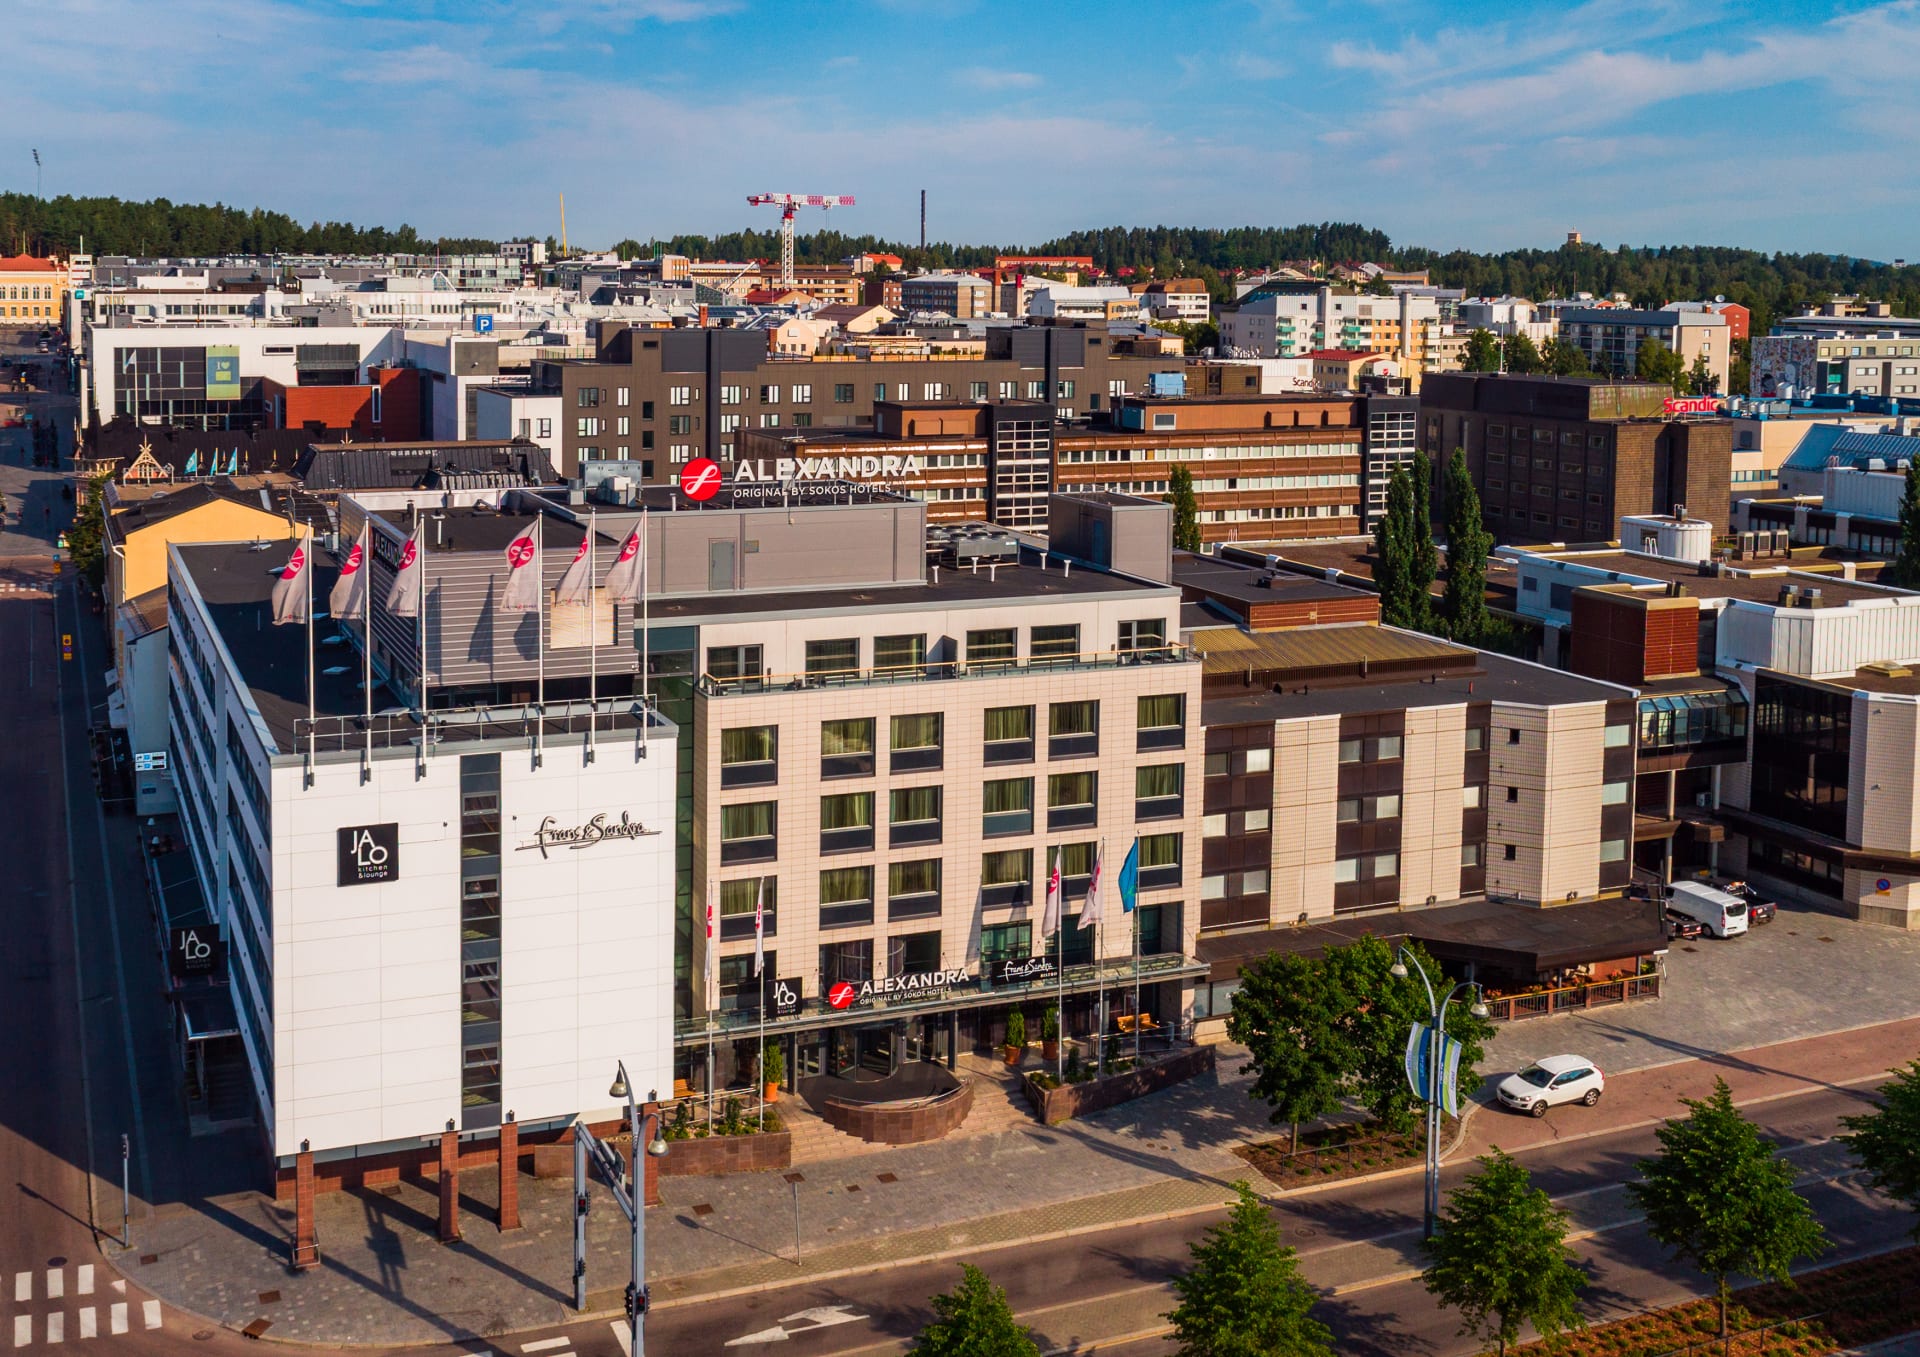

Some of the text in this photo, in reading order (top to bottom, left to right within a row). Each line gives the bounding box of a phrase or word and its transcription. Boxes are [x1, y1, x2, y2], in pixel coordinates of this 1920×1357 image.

[1663, 395, 1719, 413] Scandic
[734, 454, 921, 482] ALEXANDRA
[733, 483, 892, 498] ORIGINAL BY SOKOS HOTELS
[860, 968, 970, 995] ALEXANDRA
[893, 993, 902, 1001] BY
[903, 990, 926, 999] SOKOS
